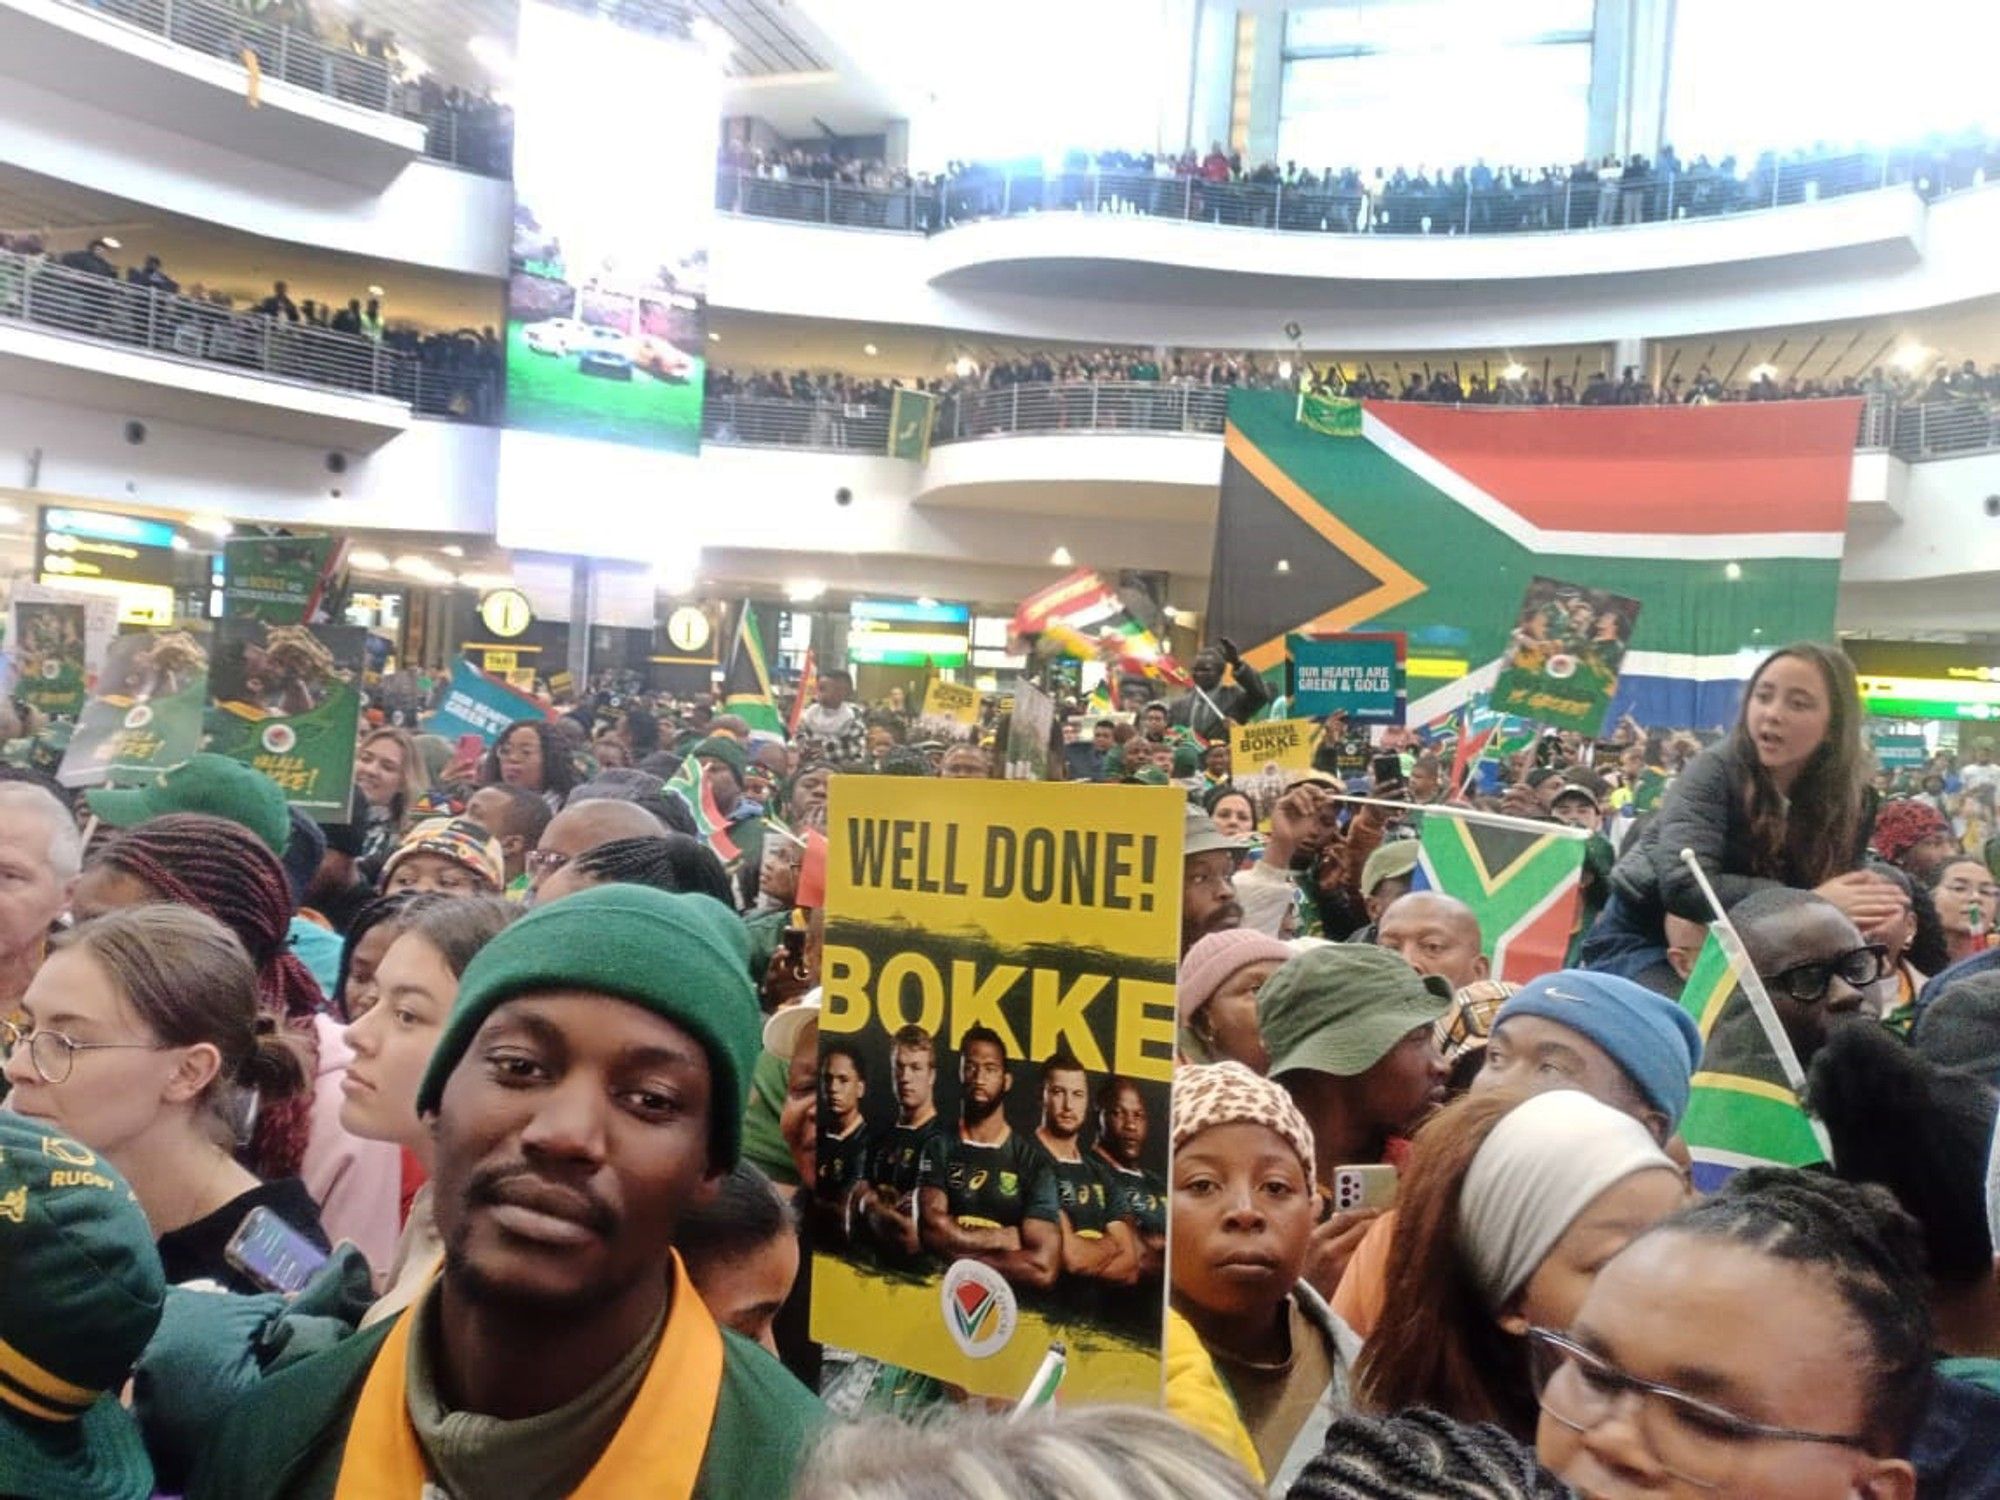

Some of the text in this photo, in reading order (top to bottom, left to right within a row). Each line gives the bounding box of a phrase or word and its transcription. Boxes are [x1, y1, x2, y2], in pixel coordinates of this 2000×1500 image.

[1321, 667, 1363, 678] HEARTS
[1366, 667, 1389, 678] ARE
[1299, 679, 1337, 691] GREEN
[1354, 679, 1390, 692] GOLD
[1240, 734, 1302, 752] BOKKE
[847, 817, 1158, 912] WELL DONE!
[818, 944, 1176, 1083] BOKKE
